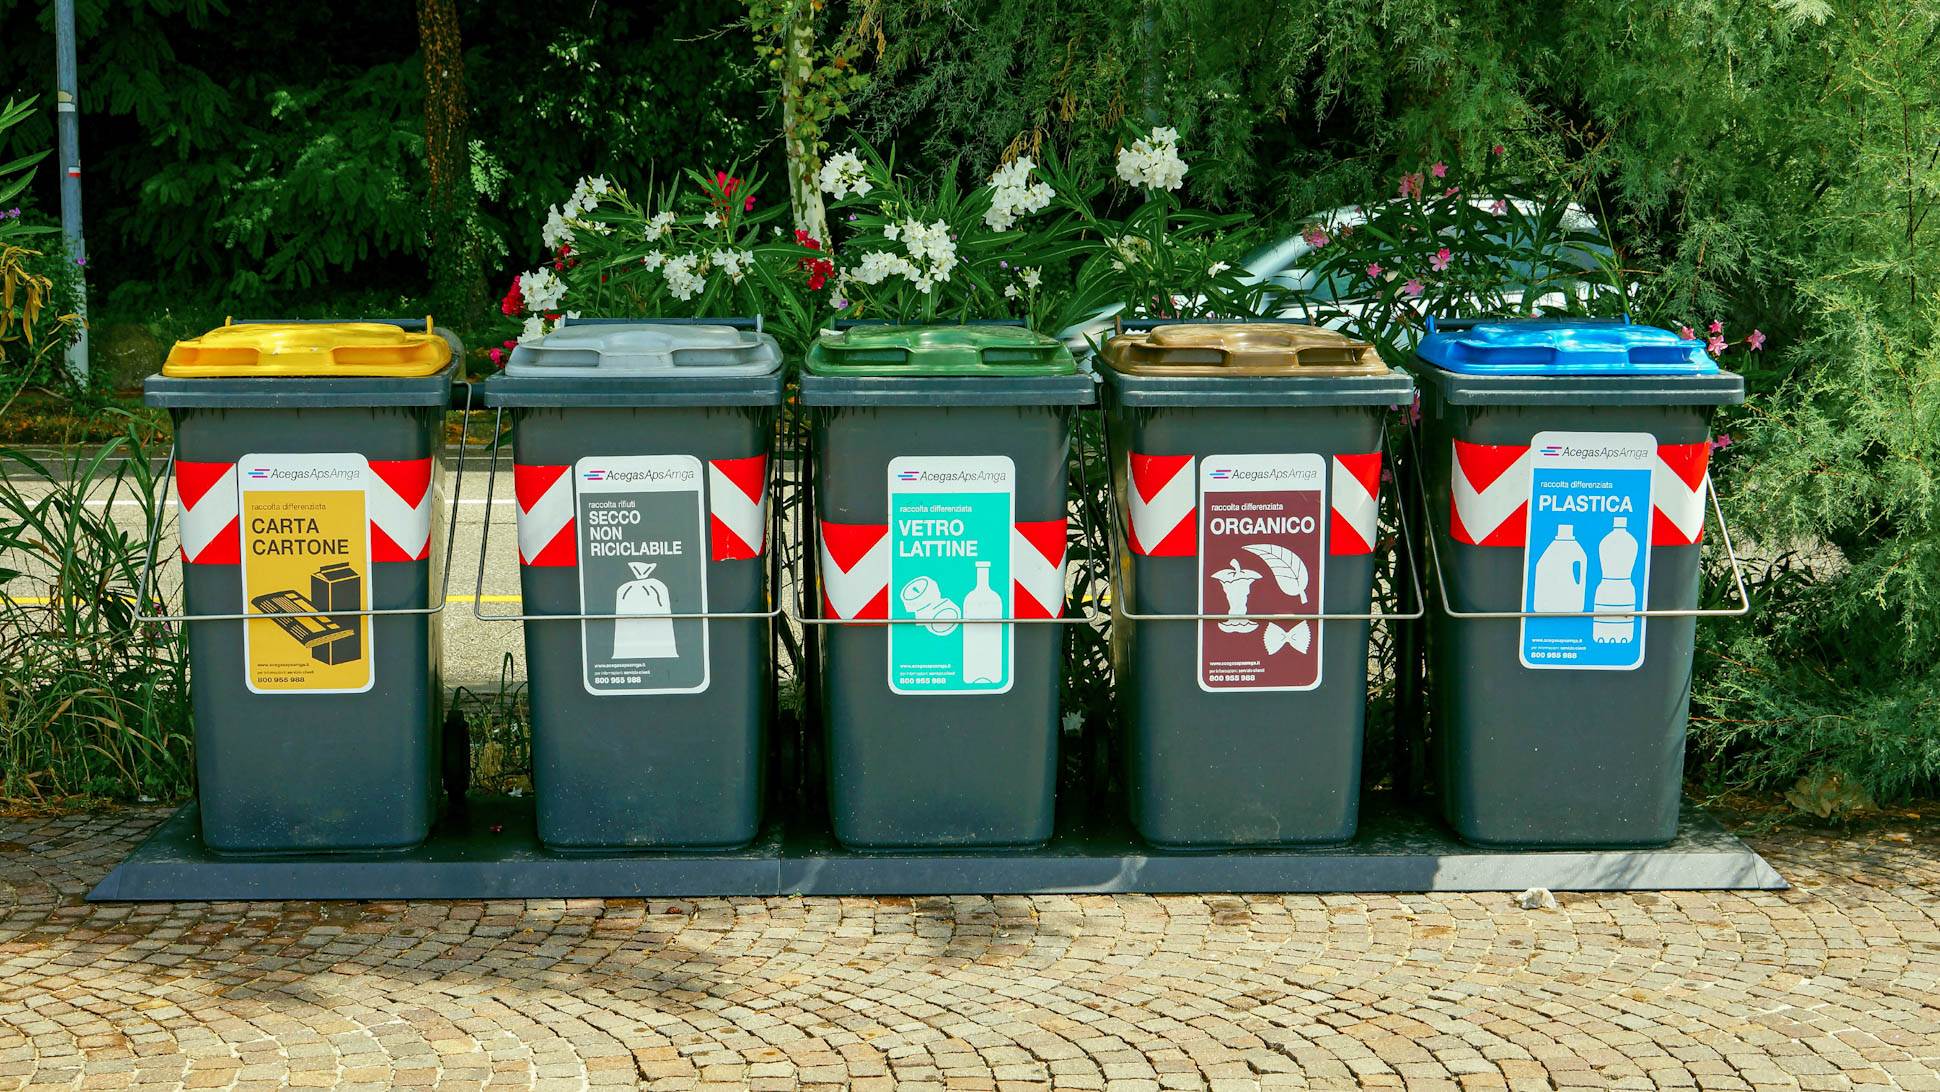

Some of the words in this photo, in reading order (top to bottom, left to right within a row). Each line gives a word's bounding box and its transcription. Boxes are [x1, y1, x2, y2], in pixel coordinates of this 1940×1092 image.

[1562, 447, 1648, 459] AcegasApsAmga
[271, 468, 360, 481] AcegasApsAmga
[606, 469, 694, 482] AcegasApsAmga
[920, 470, 1006, 483] AcegasApsAmga
[1232, 468, 1317, 481] AcegasApsAmga
[1570, 480, 1613, 488] differenziata
[588, 501, 617, 509] raccolta
[618, 500, 636, 508] rifiuti
[930, 504, 972, 512] differenziata
[1211, 503, 1240, 511] raccolta
[1241, 503, 1283, 511] differenziata
[1539, 495, 1633, 512] PLASTICA
[589, 510, 641, 525] SECCO
[251, 518, 320, 534] CARTA
[898, 519, 964, 536] VETRO
[1210, 516, 1316, 535] ORGANICO
[590, 526, 623, 540] NON
[252, 539, 349, 555] CARTONE
[590, 541, 683, 556] RICICLABILE
[899, 540, 978, 557] LATTINE
